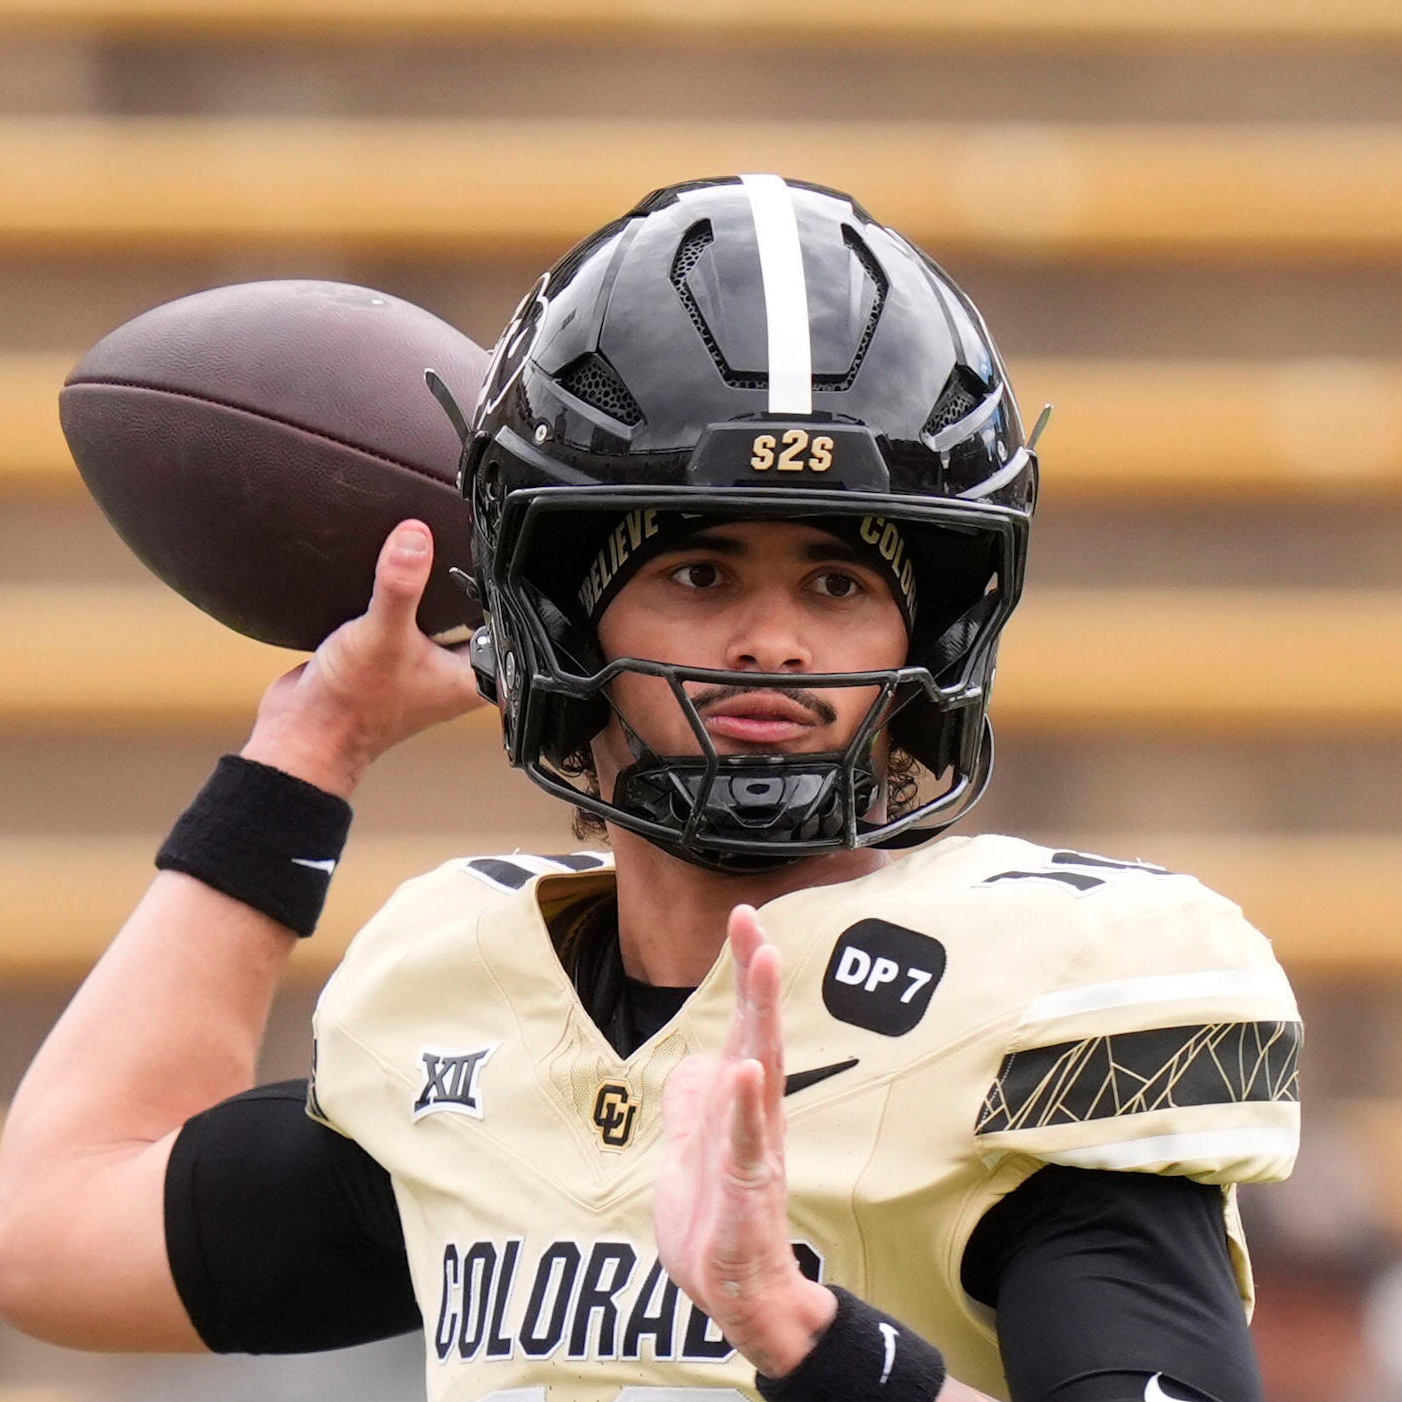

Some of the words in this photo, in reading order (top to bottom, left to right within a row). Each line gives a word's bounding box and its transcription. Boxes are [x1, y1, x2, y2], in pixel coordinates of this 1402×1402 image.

[577, 507, 659, 618] BELIEVE
[834, 945, 900, 993] DP
[899, 967, 933, 1004] 7
[592, 1083, 638, 1148] CU
